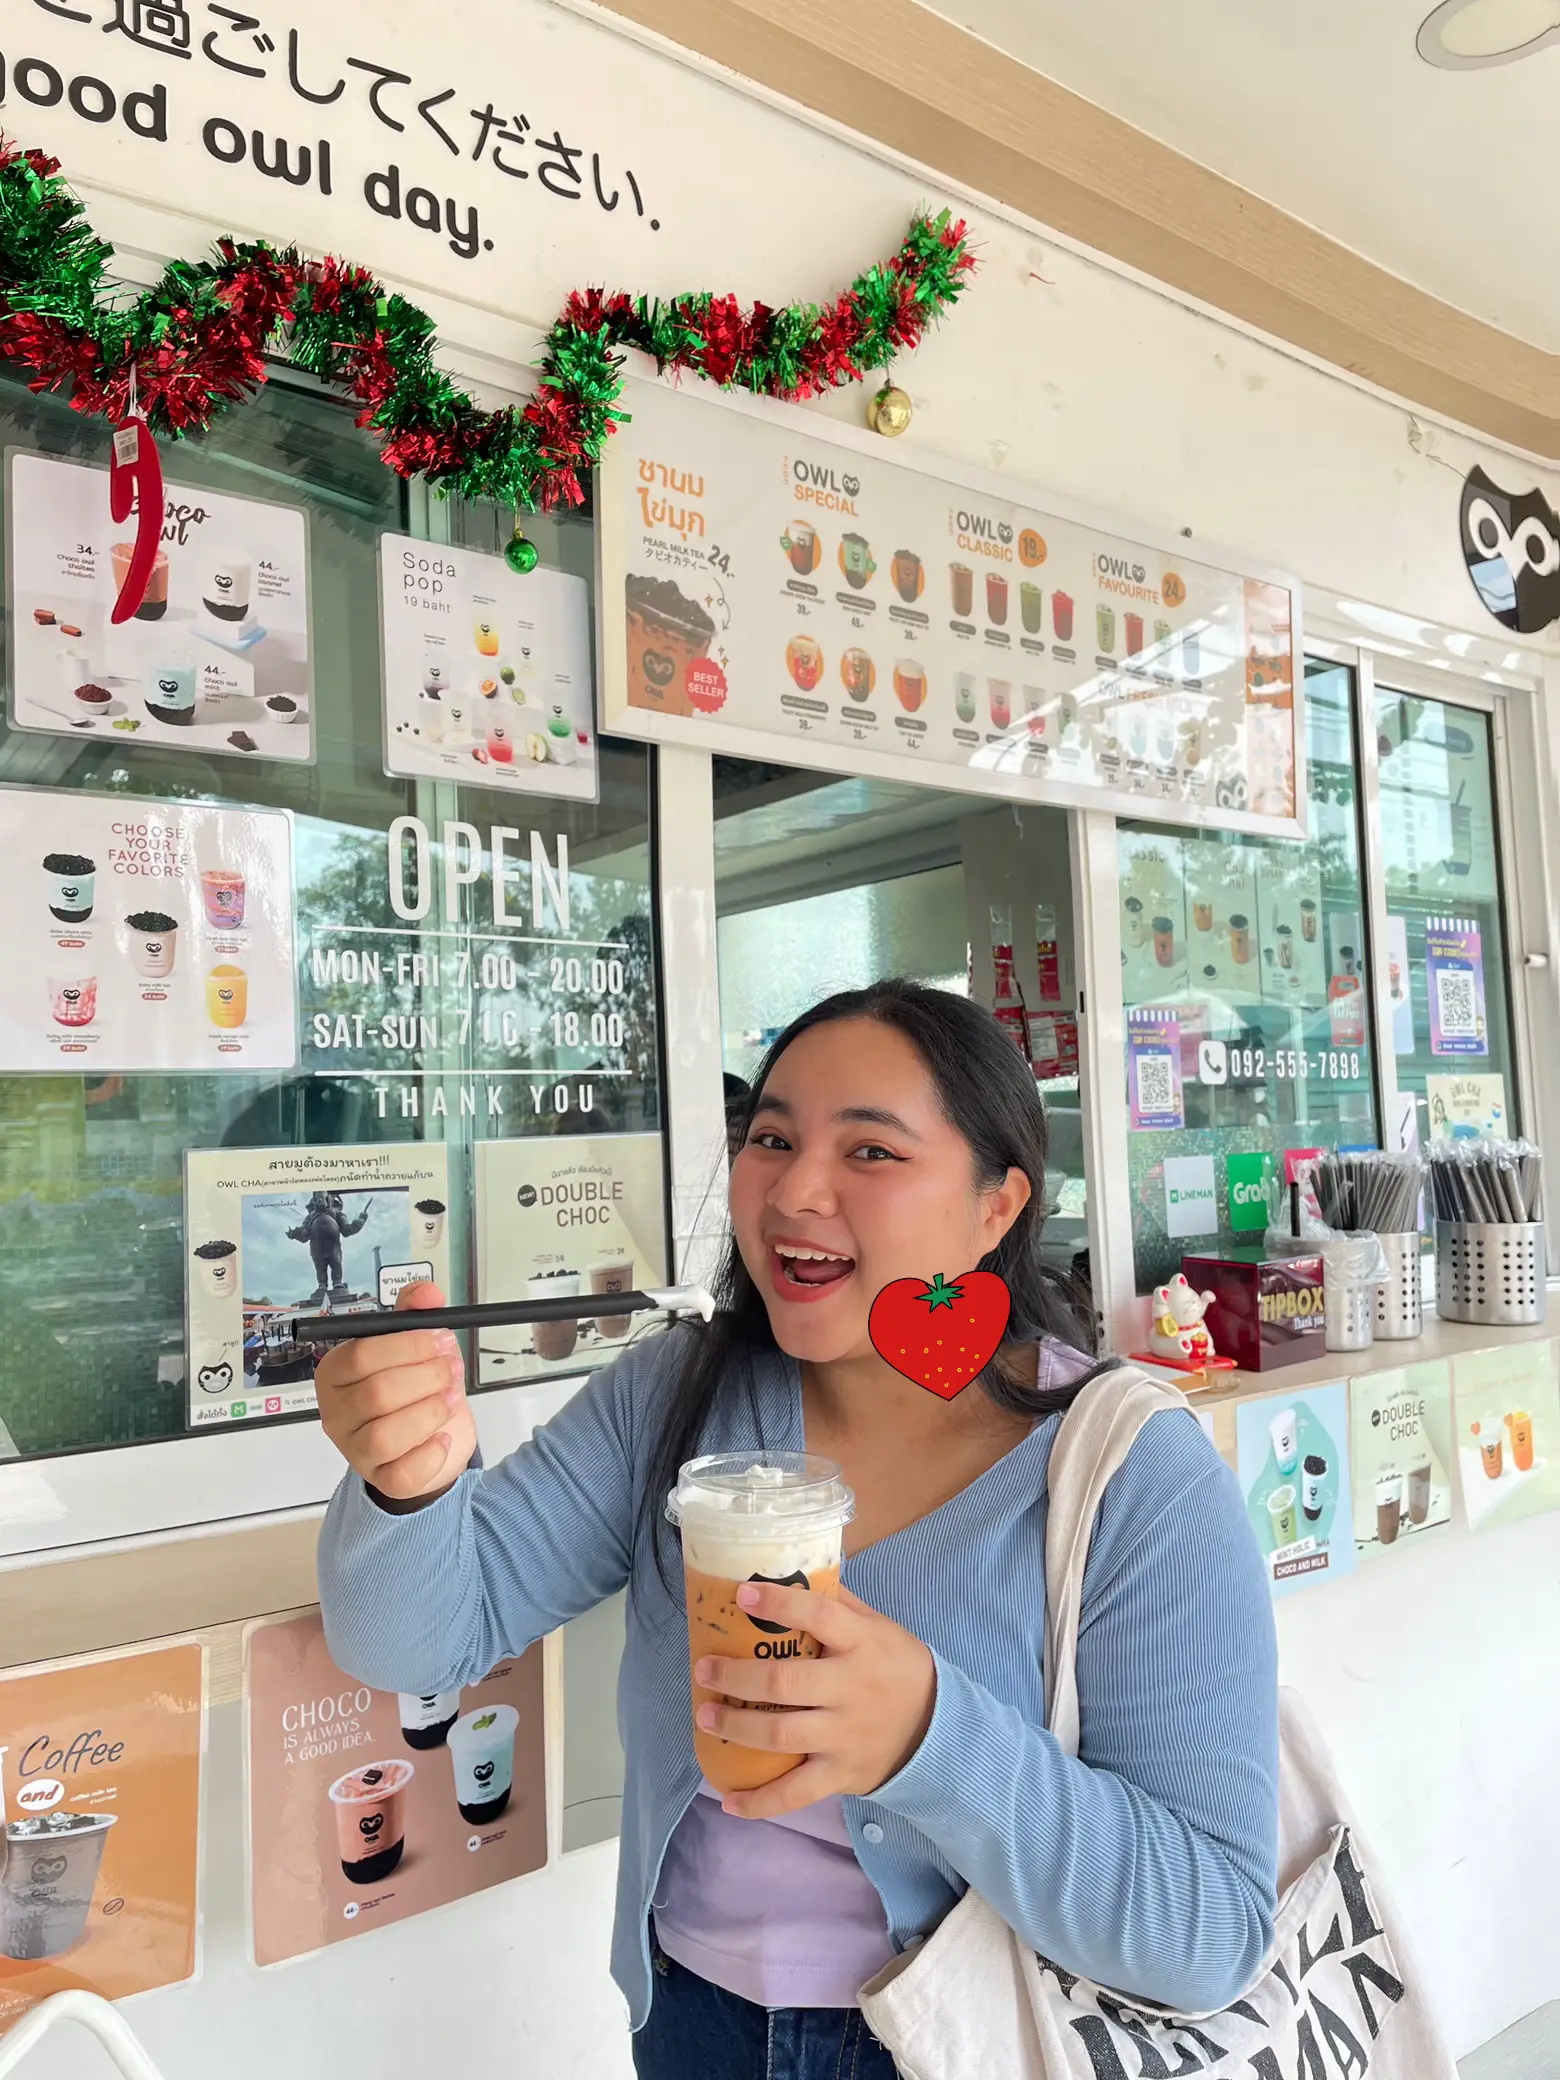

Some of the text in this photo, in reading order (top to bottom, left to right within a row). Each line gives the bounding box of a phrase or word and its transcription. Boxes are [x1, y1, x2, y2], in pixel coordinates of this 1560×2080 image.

[0, 51, 494, 258] ood owl day.
[638, 458, 704, 497] ชานม
[793, 459, 842, 493] OWL
[636, 486, 705, 541] ไข่มุก
[794, 484, 860, 518] SPECIAL
[956, 510, 997, 541] OWL
[643, 536, 705, 561] PEARL MILK TEA
[957, 534, 1014, 564] CLASSIC
[402, 551, 457, 578] Soda
[1098, 554, 1133, 581] OWL
[403, 573, 444, 595] pop
[1098, 575, 1159, 605] FAVOURITE
[404, 596, 452, 613] 19 baht
[687, 682, 725, 699] SELLER
[693, 671, 719, 685] BEST
[111, 823, 185, 840] CHOOSE
[125, 838, 171, 851] YOUR
[108, 849, 189, 866] FAVORITE
[113, 863, 184, 878] COLORS
[387, 815, 571, 930] OPEN
[312, 949, 440, 988] MON-FRI
[456, 951, 517, 990] 7.00
[550, 957, 624, 994] 20.00
[313, 1013, 438, 1049] SAT-SUN
[551, 1011, 624, 1047] 18.00
[1231, 1048, 1360, 1080] 092-555-7898
[375, 1084, 594, 1118] THANK YOU
[217, 1180, 239, 1188] OWL
[541, 1181, 624, 1206] DOUBLE
[556, 1205, 611, 1227] CHOC
[1382, 1400, 1426, 1425] DOUBLE
[1390, 1421, 1419, 1441] CHOC
[1277, 1555, 1327, 1577] CHOCO AND MILK
[753, 1639, 802, 1660] OWL
[282, 1687, 372, 1732] CHOCO
[283, 1718, 361, 1750] IS ALWAYS
[18, 1729, 125, 1777] Coffee
[284, 1753, 294, 1765] A
[300, 1738, 338, 1762] GOOD
[20, 1783, 60, 1803] and
